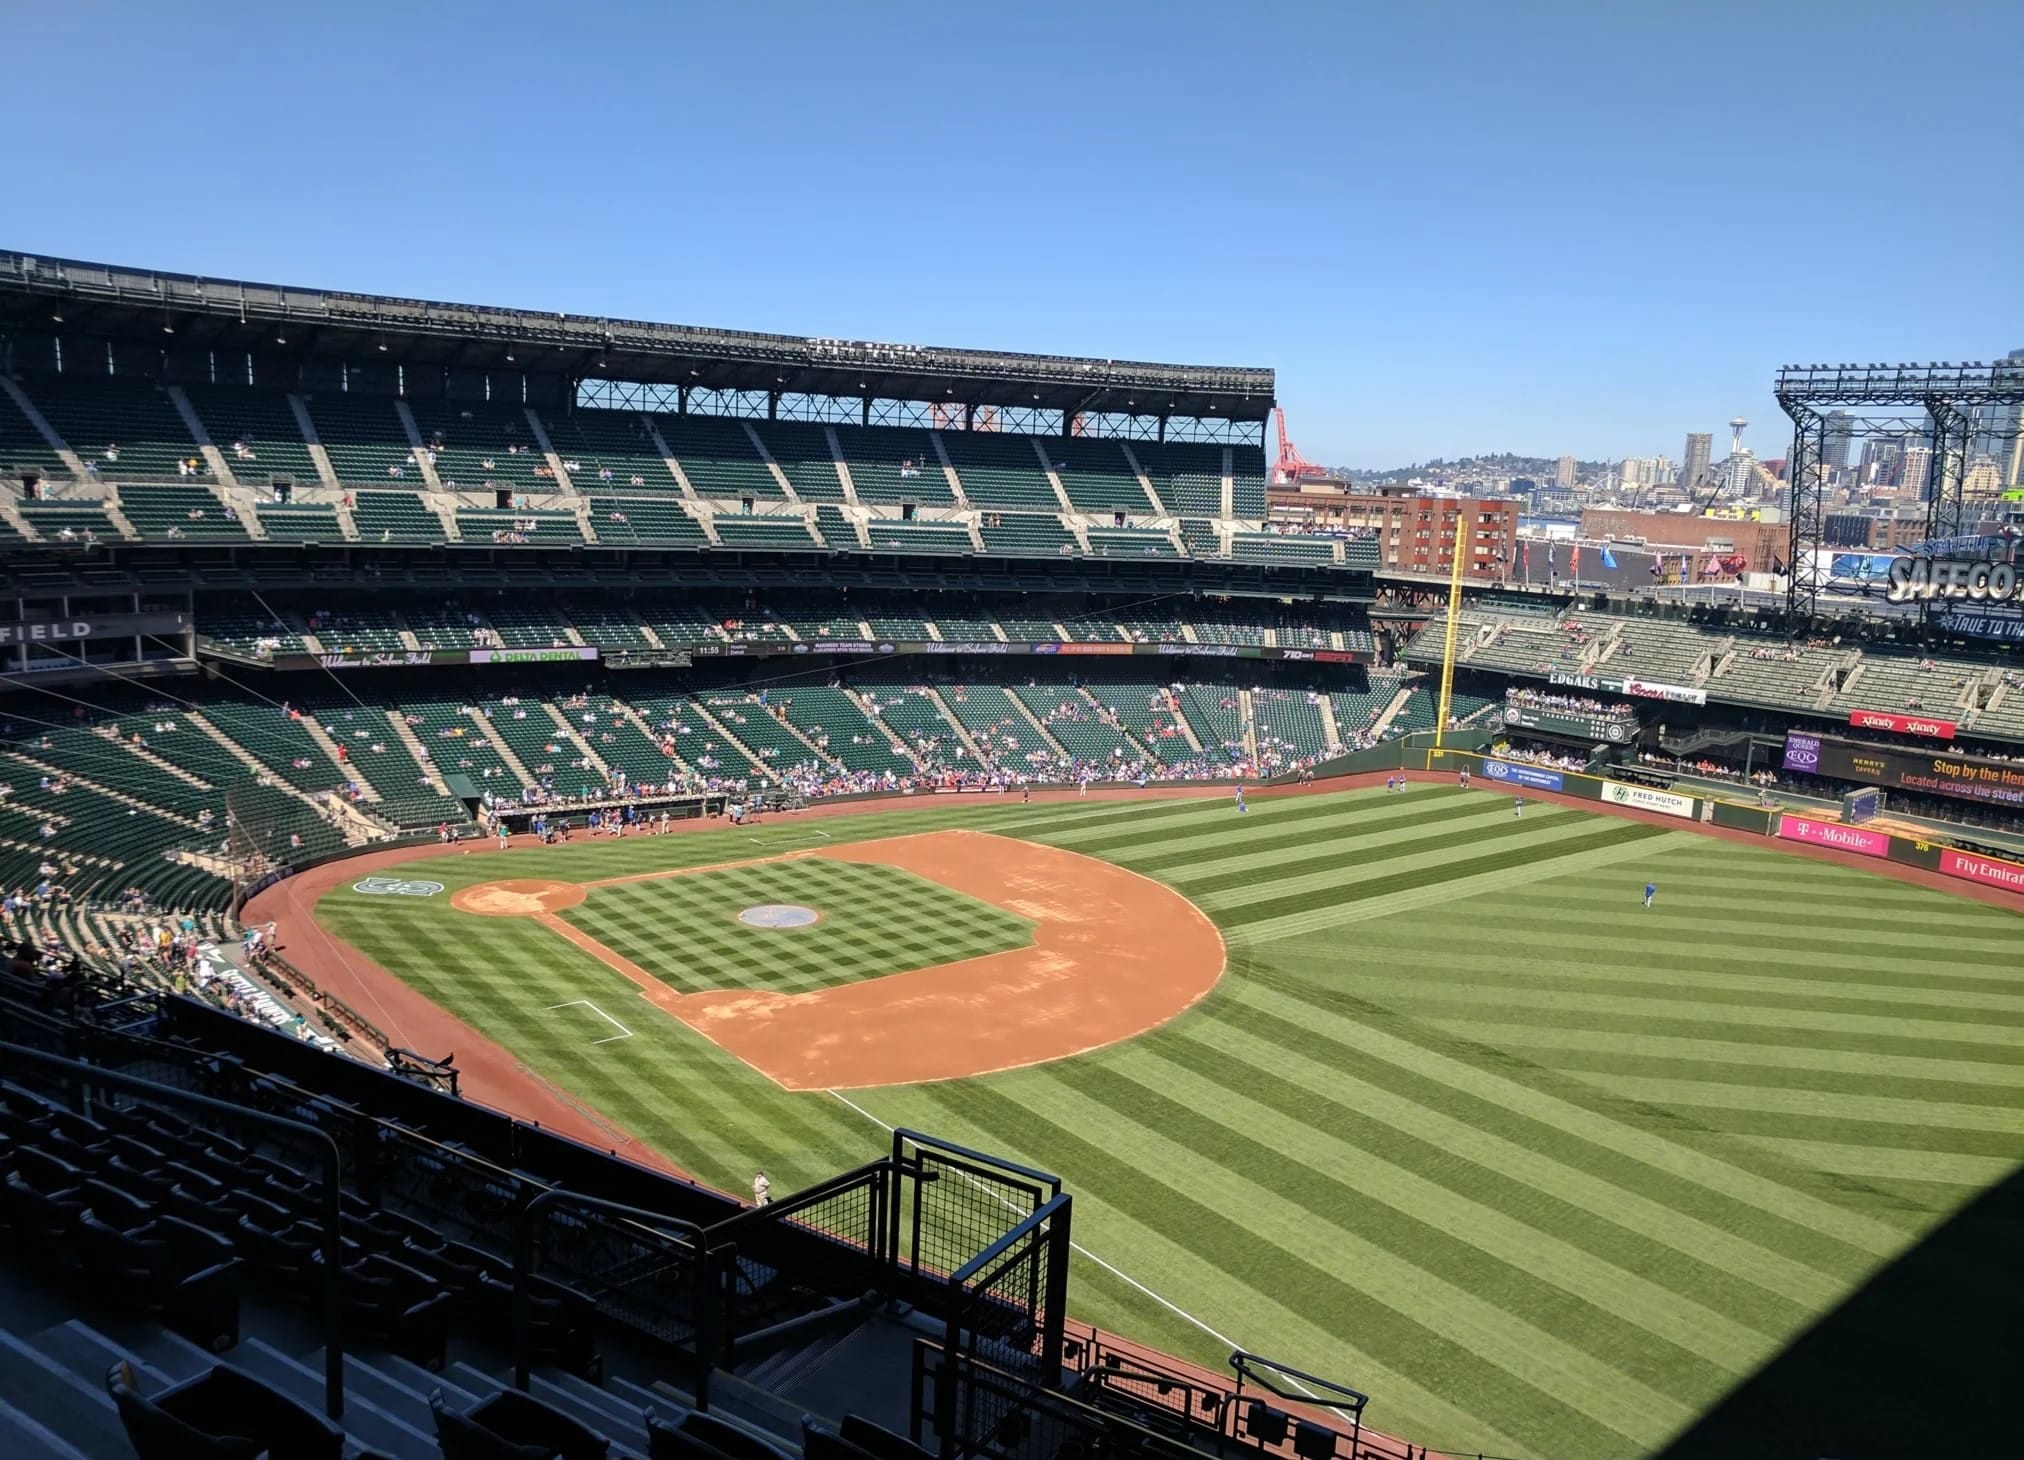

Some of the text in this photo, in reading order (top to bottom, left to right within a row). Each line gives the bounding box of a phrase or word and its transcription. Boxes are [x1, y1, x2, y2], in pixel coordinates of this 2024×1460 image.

[1887, 556, 2016, 604] SAFECO
[0, 622, 91, 642] FIELD
[1953, 614, 1987, 632] TRUE
[1987, 620, 2005, 634] TO
[505, 651, 582, 662] DELTA DENTAL
[699, 646, 719, 655] 11:55
[1283, 650, 1302, 659] 710
[1630, 683, 1665, 699] Coors
[1862, 716, 1896, 730] xfinity
[1906, 721, 1941, 736] xfinity
[1789, 737, 1820, 747] EMERALD
[1787, 750, 1817, 763] EQC
[1933, 760, 1960, 778] Stop
[1962, 764, 1977, 781] by
[1980, 767, 1998, 782] the
[1901, 772, 2024, 802] Located across the street
[1633, 791, 1682, 807] FRED HUTCH
[1956, 857, 1978, 875] Fly
